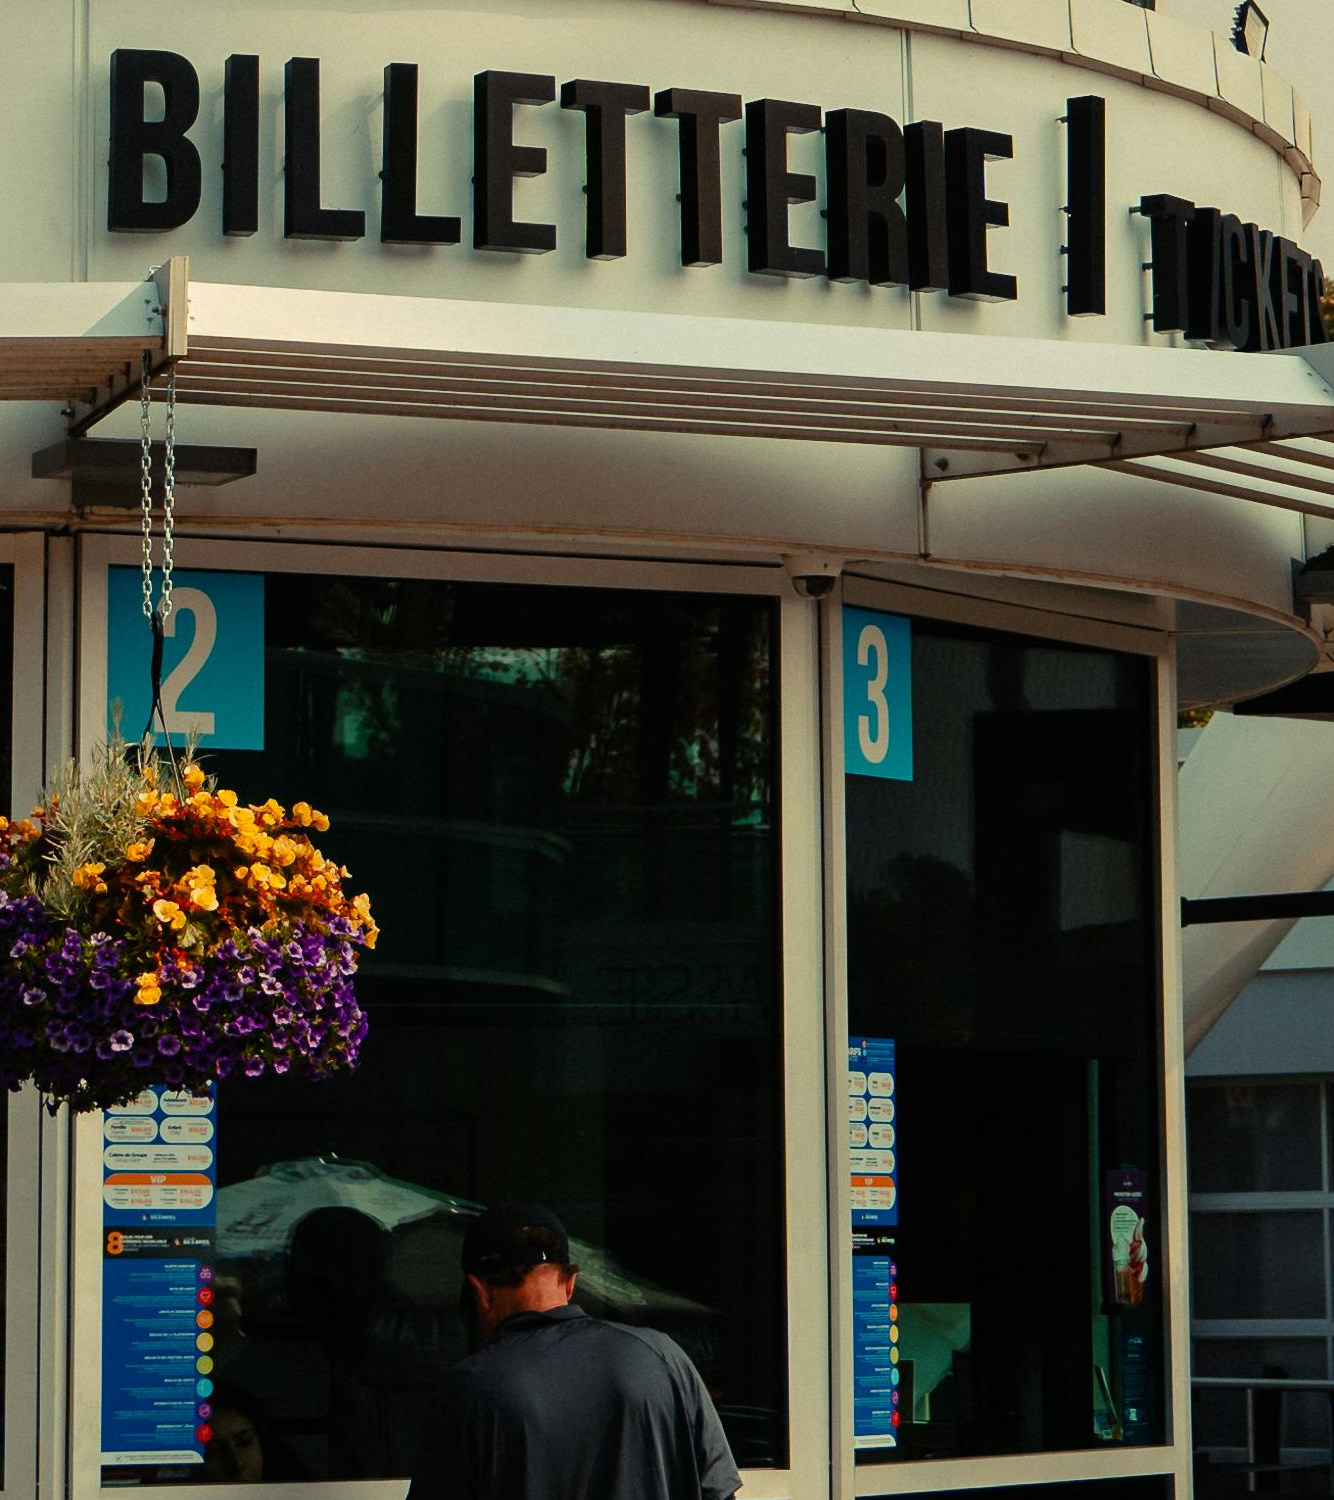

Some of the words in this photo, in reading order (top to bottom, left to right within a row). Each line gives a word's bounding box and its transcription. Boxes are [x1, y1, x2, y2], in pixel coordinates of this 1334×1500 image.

[107, 48, 1018, 303] BILLETTERIE
[153, 586, 217, 735] 2
[857, 624, 890, 764] 3
[107, 1231, 123, 1255] 8
[150, 1175, 167, 1184] VIP
